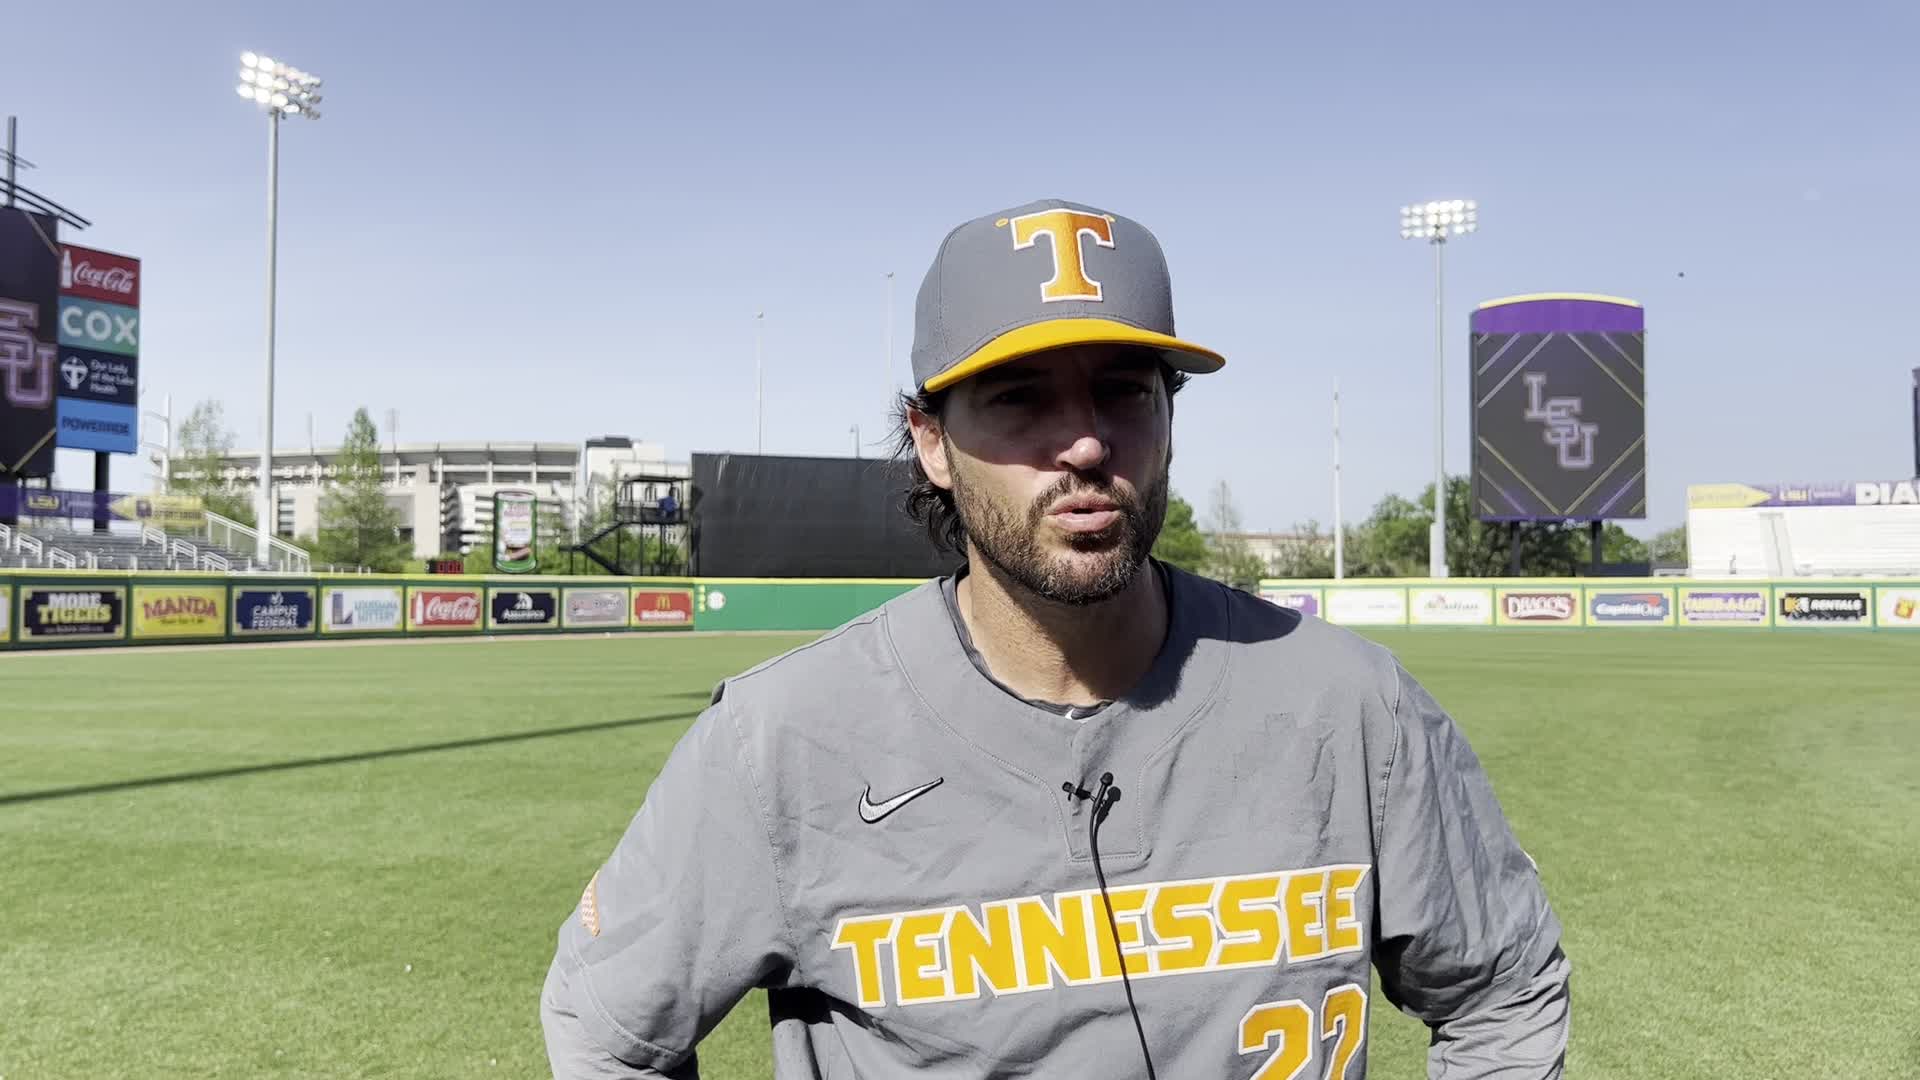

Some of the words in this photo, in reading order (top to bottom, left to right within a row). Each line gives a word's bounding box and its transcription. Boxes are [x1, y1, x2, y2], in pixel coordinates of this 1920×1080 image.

[1010, 208, 1115, 303] T
[73, 260, 135, 294] Coca-Cola
[61, 305, 137, 346] COX
[91, 359, 106, 371] Our
[108, 362, 128, 376] Lady
[90, 383, 118, 395] Health
[101, 373, 115, 382] the
[116, 375, 135, 386] Lake
[62, 415, 129, 437] POWERADE
[1523, 372, 1599, 469] LSU
[28, 495, 60, 510] LSU
[1855, 482, 1920, 505] DIA
[47, 592, 102, 608] MORE
[143, 596, 217, 619] MANDA
[352, 600, 399, 609] LOUISIANA
[427, 596, 479, 621] Coca-Cola
[1811, 599, 1862, 611] RENTALS
[38, 604, 112, 624] TIGERS
[253, 605, 298, 617] CAMPUS
[357, 610, 395, 623] LOTTERY
[252, 617, 297, 628] FEDERAL
[830, 863, 1372, 1009] TENNESSEE
[1238, 983, 1368, 1080] 22
